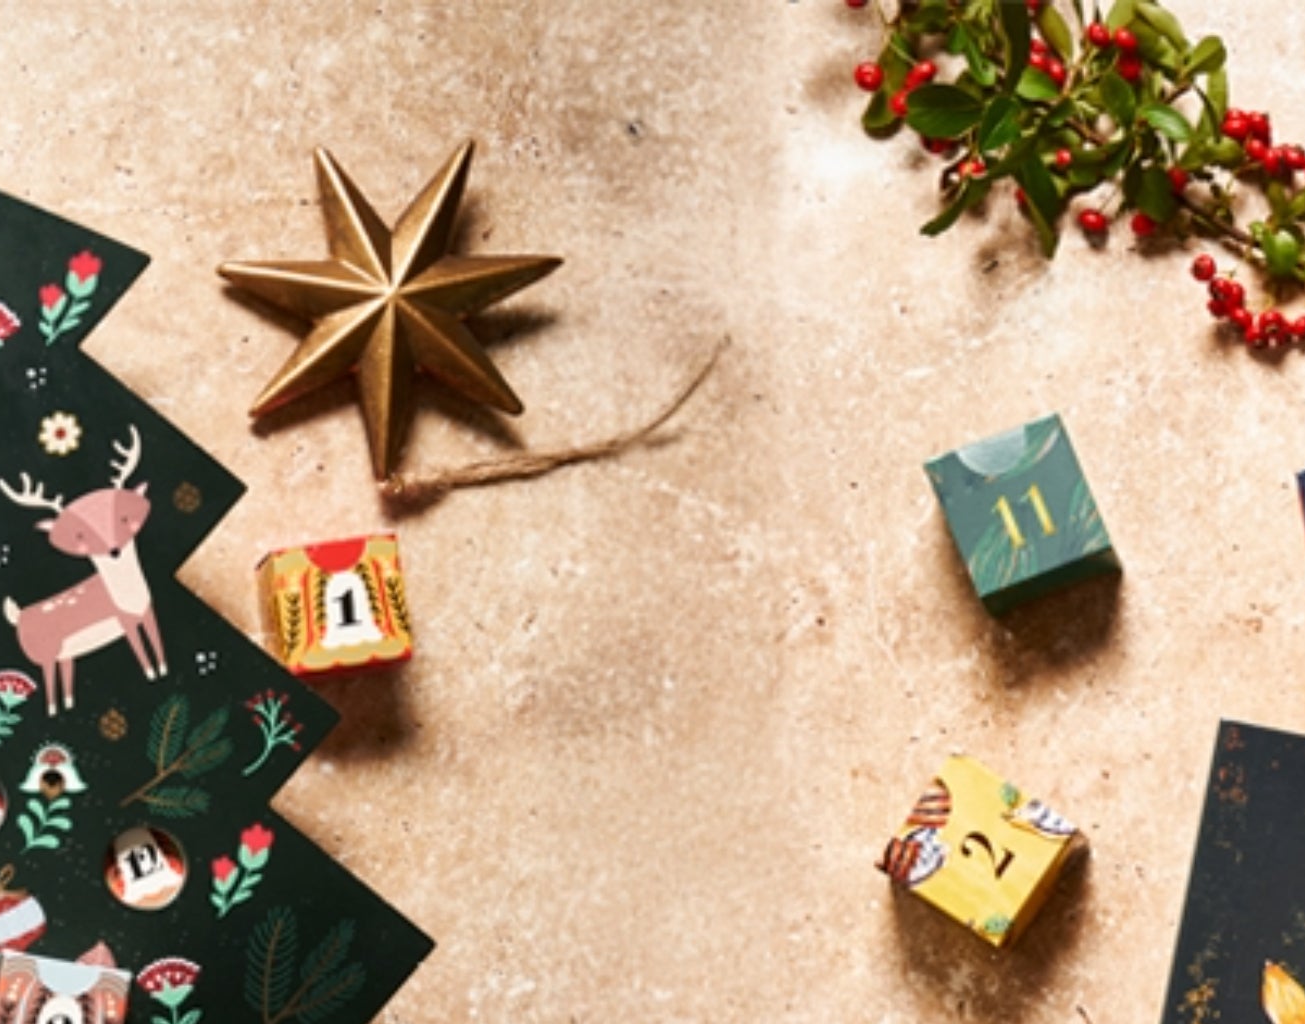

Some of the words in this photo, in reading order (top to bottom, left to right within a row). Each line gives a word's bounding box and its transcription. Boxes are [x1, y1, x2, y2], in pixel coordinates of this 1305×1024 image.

[990, 483, 1058, 549] 11
[333, 588, 360, 628] 1
[125, 842, 164, 882] 12
[960, 831, 1015, 880] 2
